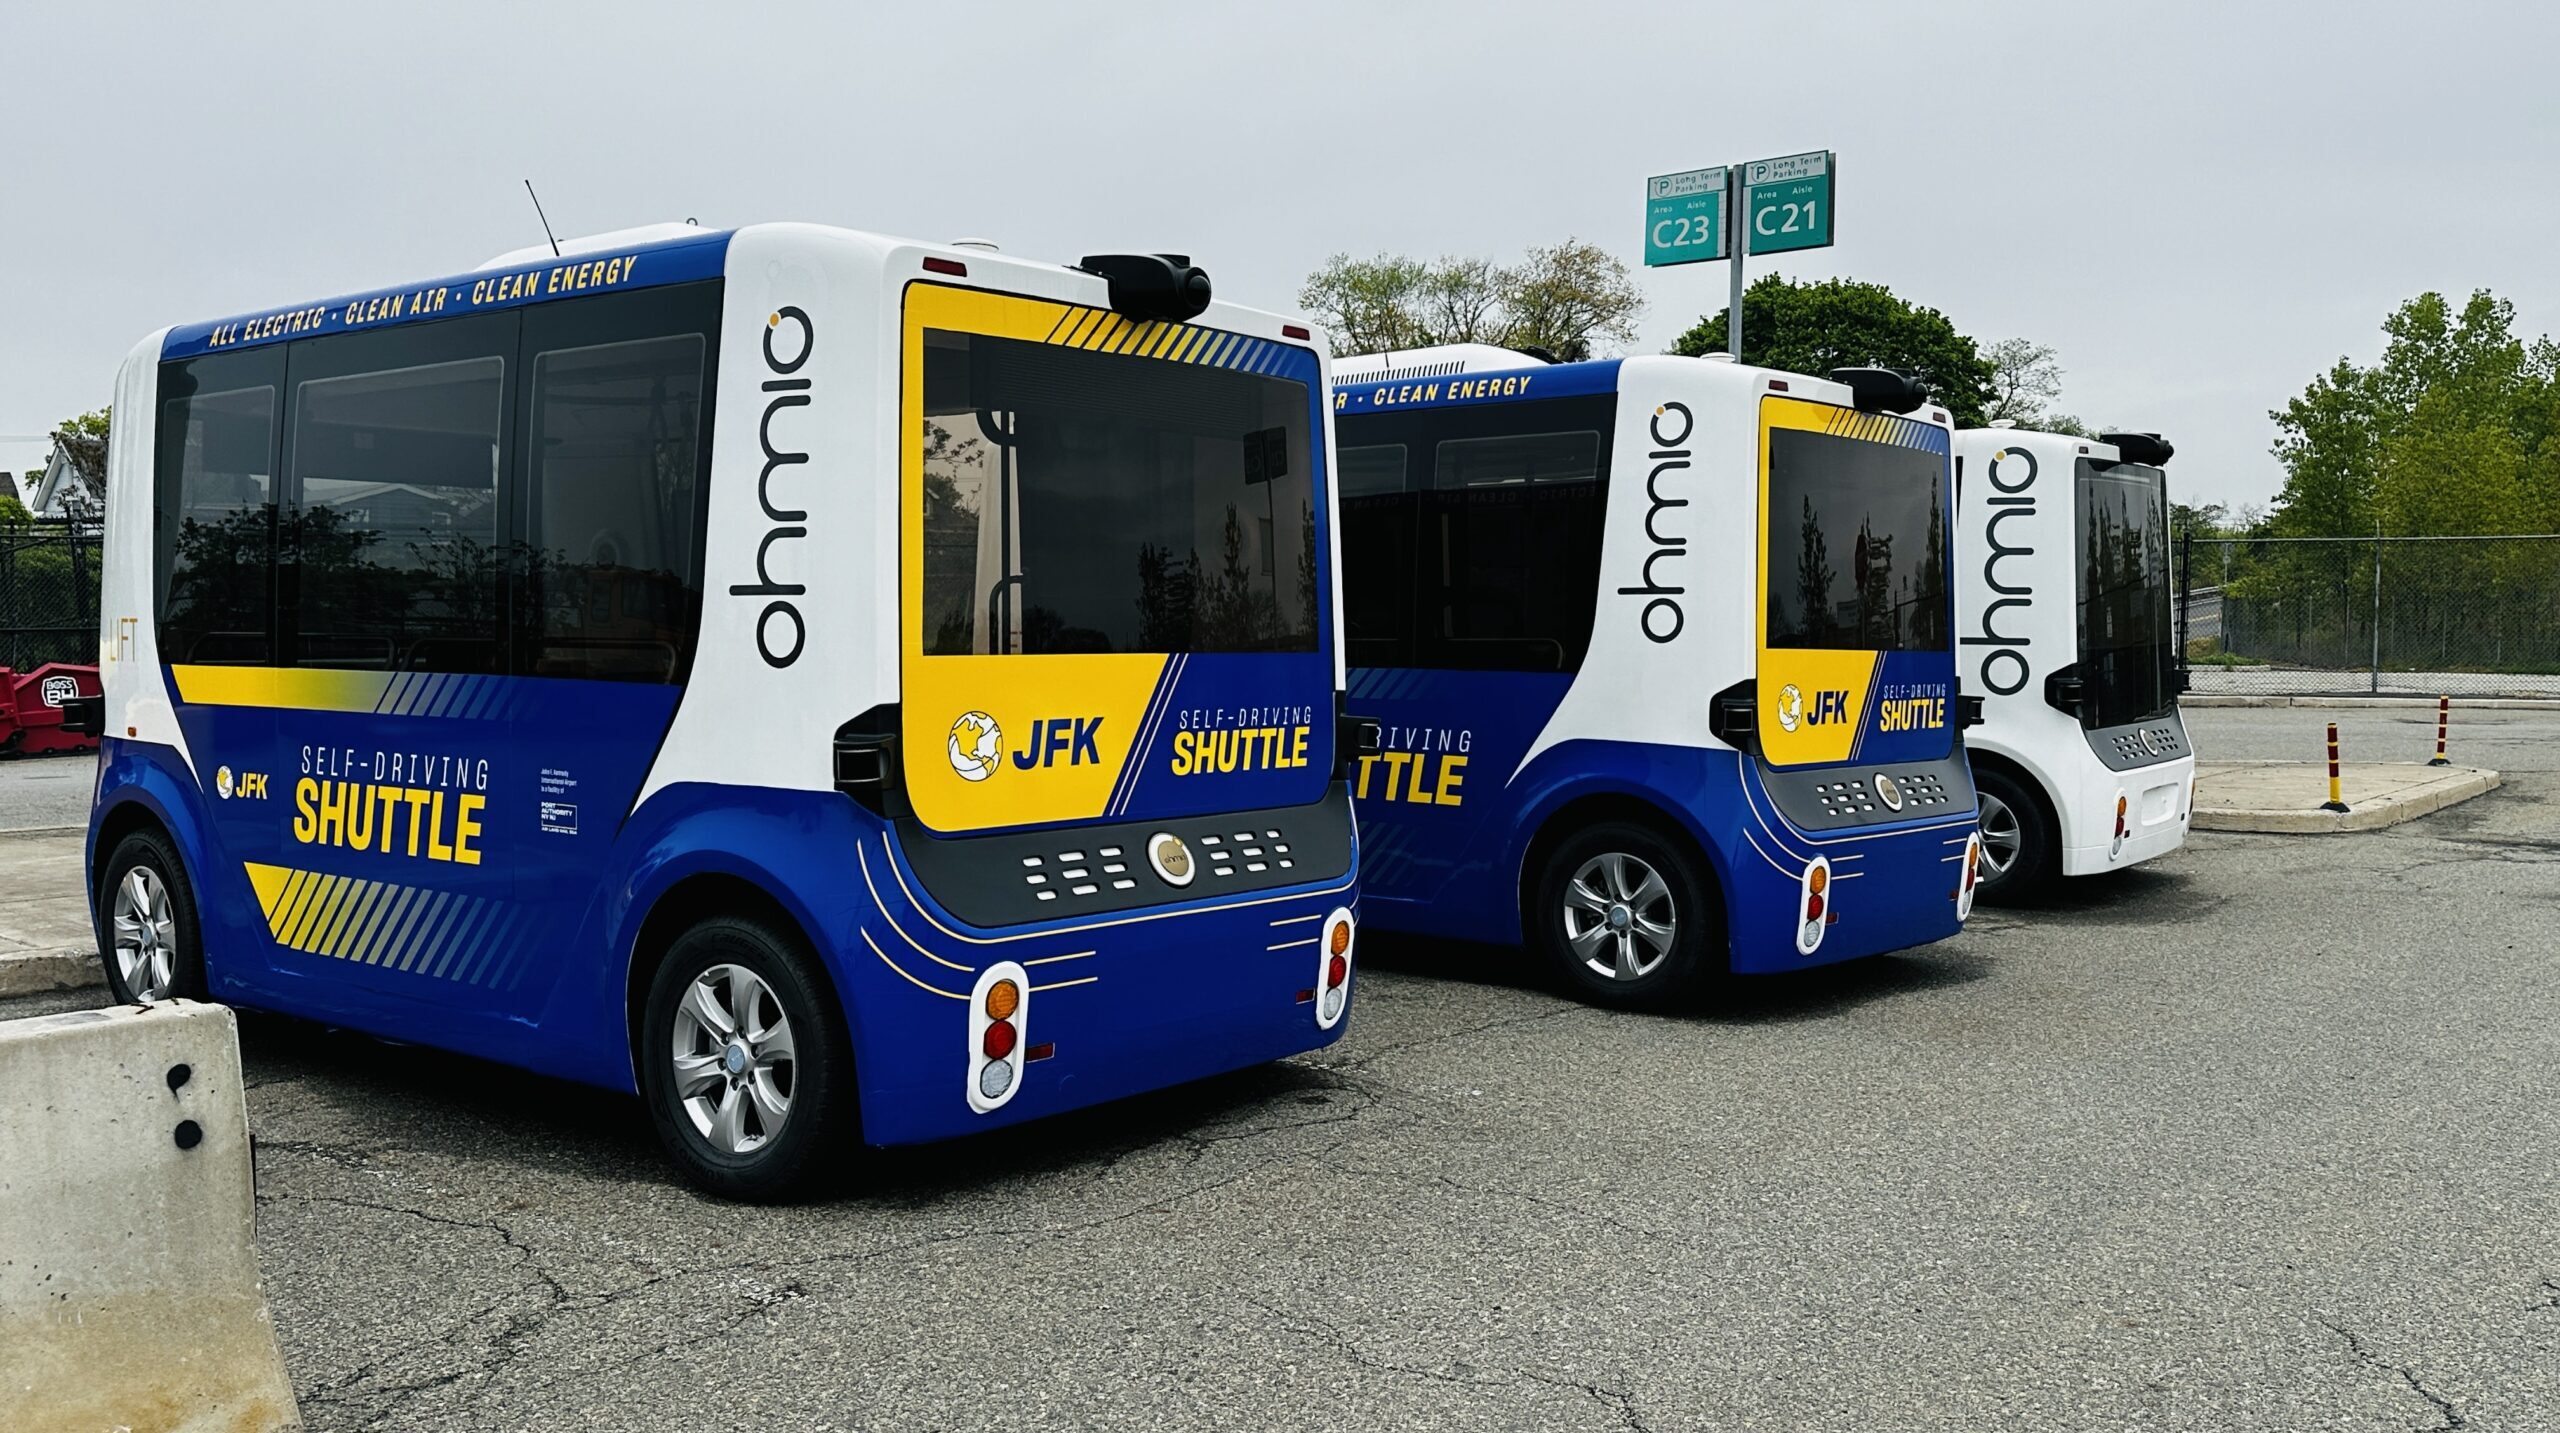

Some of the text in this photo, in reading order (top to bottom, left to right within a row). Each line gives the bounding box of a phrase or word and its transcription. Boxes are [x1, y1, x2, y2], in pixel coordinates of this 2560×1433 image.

[1675, 176, 1696, 184] Long
[1700, 171, 1721, 180] Term
[1773, 161, 1795, 170] Long
[1800, 156, 1821, 165] Term
[1773, 168, 1808, 178] Parking
[1675, 183, 1708, 193] Parking
[1757, 184, 1813, 200] Area Aisle
[1653, 200, 1706, 214] Area Aisle
[1755, 200, 1816, 236] C21
[1652, 215, 1709, 248] C23
[209, 255, 638, 348] ALL ELECTRIC CLEAN AIR CLEAN ENERGY
[1373, 383, 1439, 406] CLEAN
[1447, 376, 1532, 400] ENERGY
[729, 305, 814, 669] ohmio
[1617, 401, 1693, 644] ohmio
[1960, 446, 2038, 696] ohmio
[110, 618, 138, 661] LIFT
[46, 679, 73, 690] BOSS
[1883, 683, 1946, 699] SELF-DRIVING
[1179, 705, 1312, 730] SELF-DRIVING
[1807, 690, 1849, 726] JFK
[1880, 697, 1945, 732] SHUTTLE
[1012, 716, 1104, 771] JFK
[1171, 725, 1311, 776] SHUTTLE
[301, 745, 489, 791] SELF-DRIVING
[1357, 751, 1468, 807] TTLE
[236, 772, 269, 800] JFK
[293, 777, 486, 866] SHUTTLE
[541, 808, 573, 816] AUTHORITY
